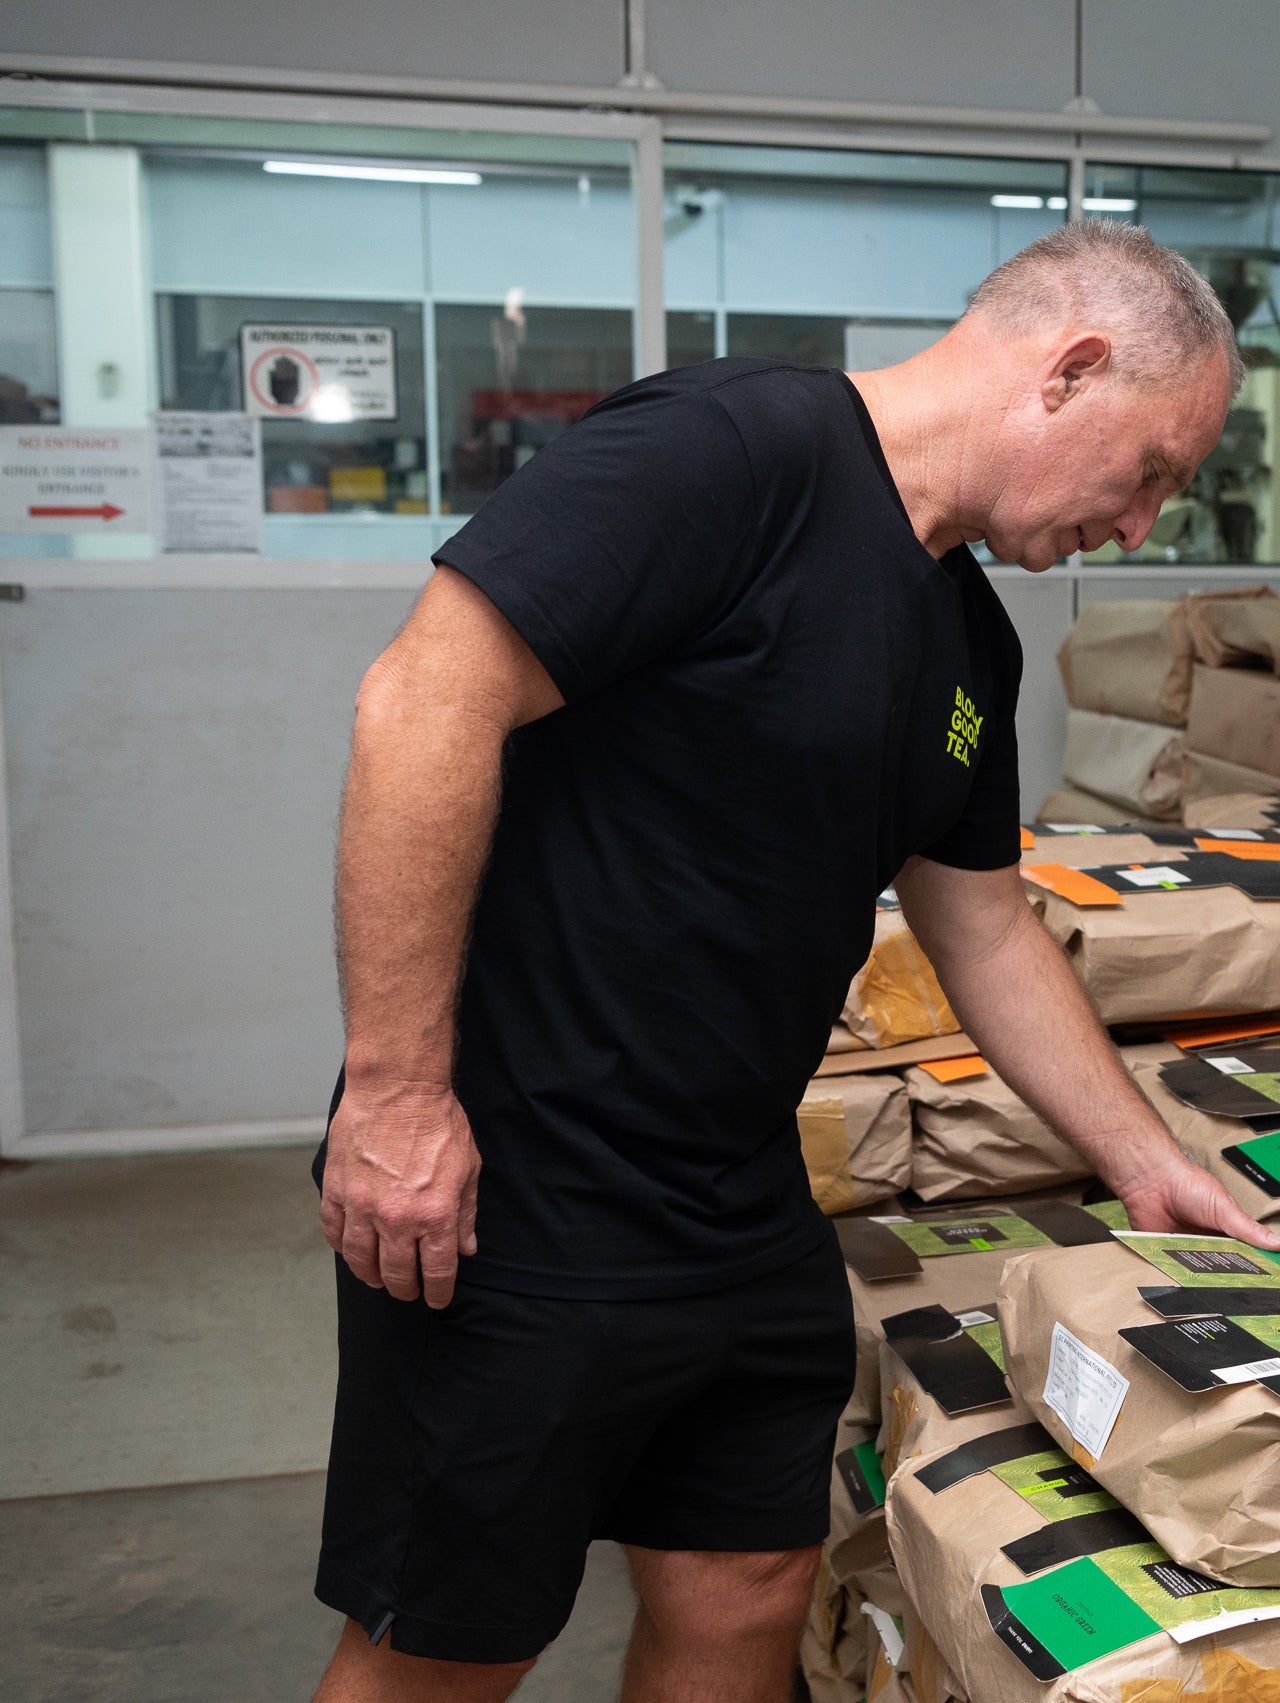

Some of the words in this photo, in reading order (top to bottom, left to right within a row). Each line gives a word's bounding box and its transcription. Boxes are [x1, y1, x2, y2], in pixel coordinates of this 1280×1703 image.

[18, 437, 40, 450] NO
[45, 437, 119, 451] ENTRANCE
[38, 482, 105, 495] ENTRANCE
[1052, 1593, 1078, 1618] ORGANIC
[1075, 1616, 1096, 1635] GREEN
